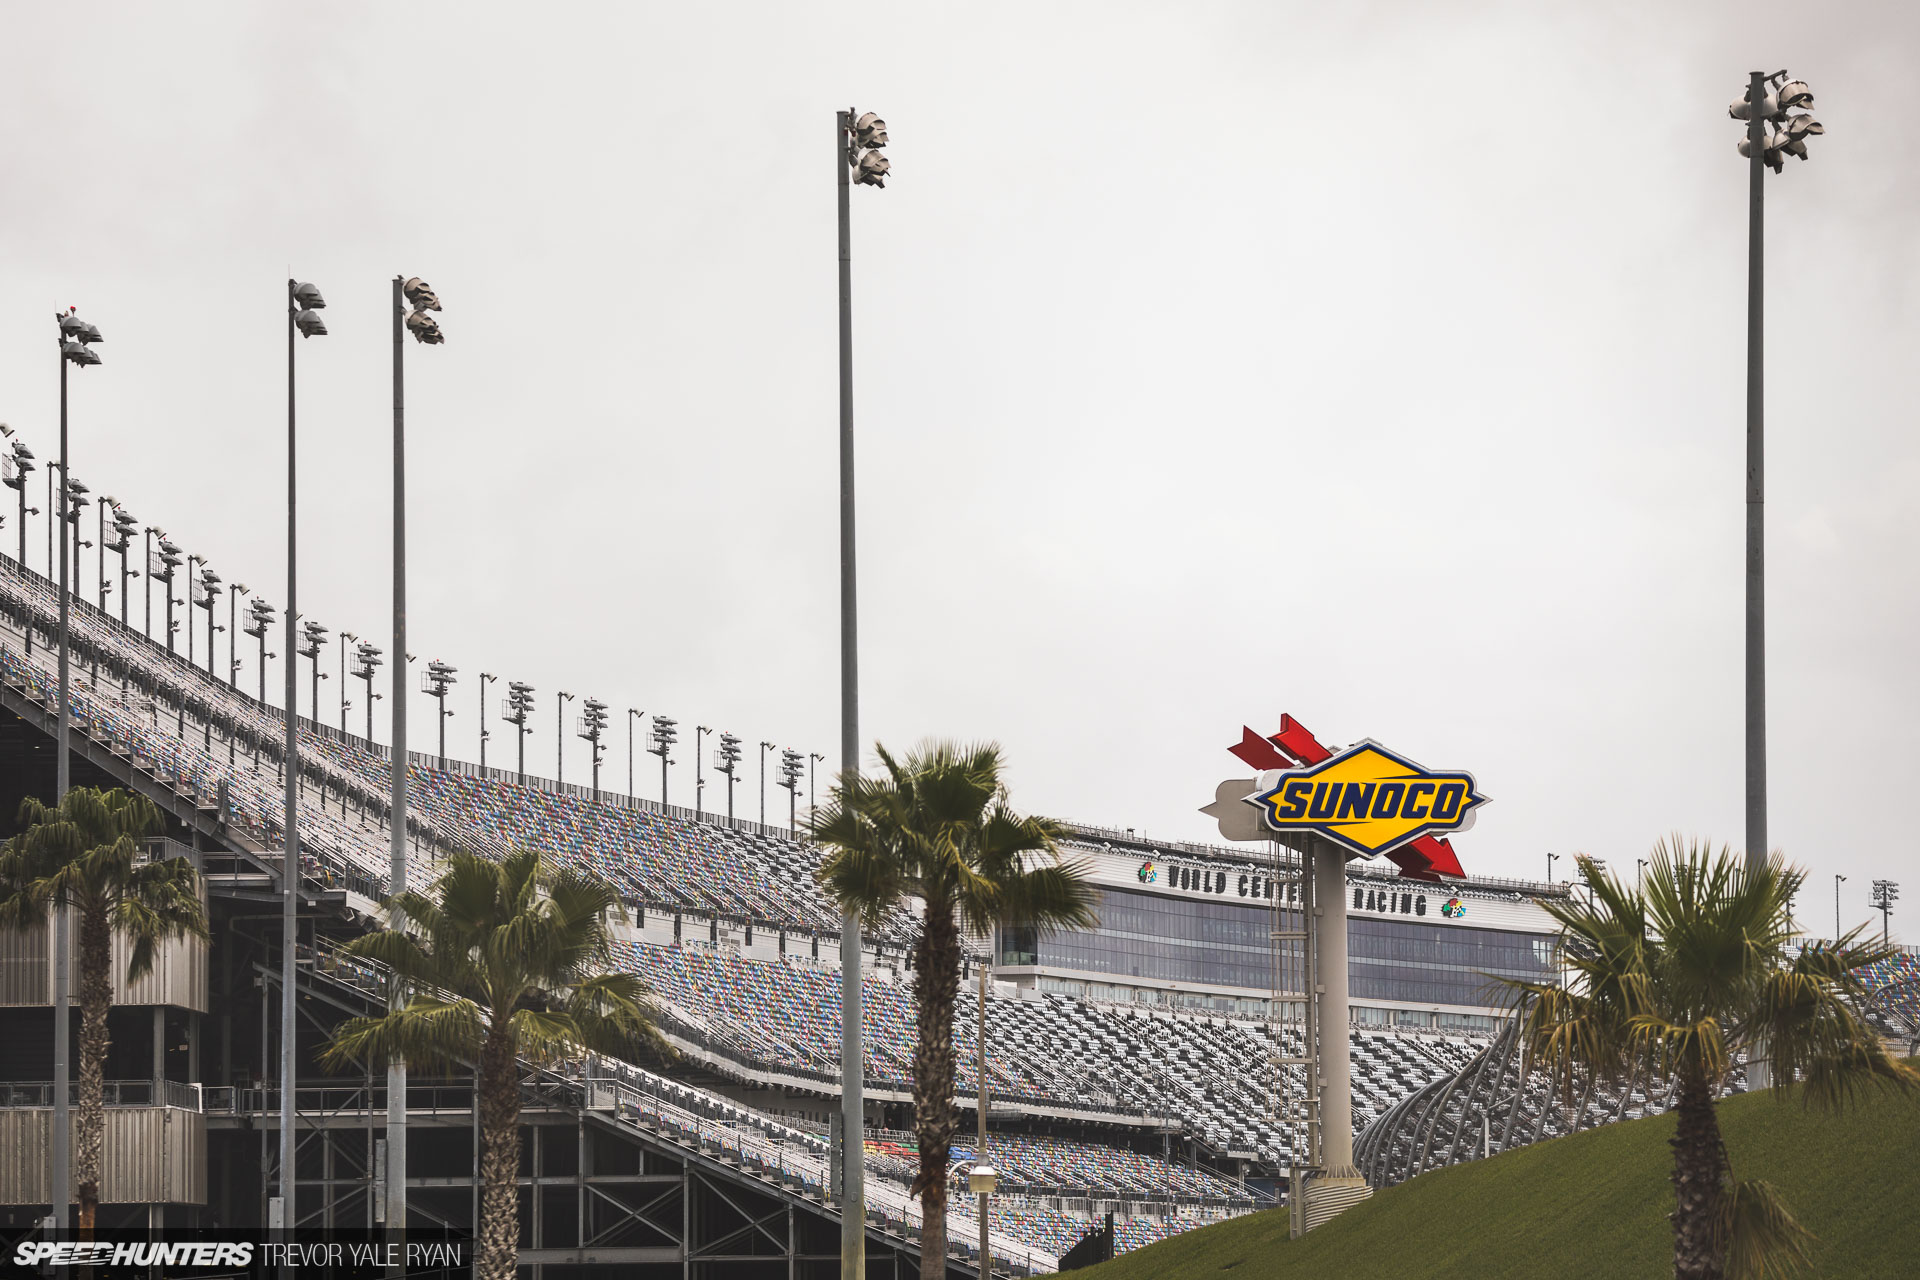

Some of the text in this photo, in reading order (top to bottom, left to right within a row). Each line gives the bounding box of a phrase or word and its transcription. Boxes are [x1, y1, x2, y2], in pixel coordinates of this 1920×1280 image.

[1278, 782, 1465, 819] SUNOCO
[1168, 865, 1427, 916] WORLD CENTE RACING
